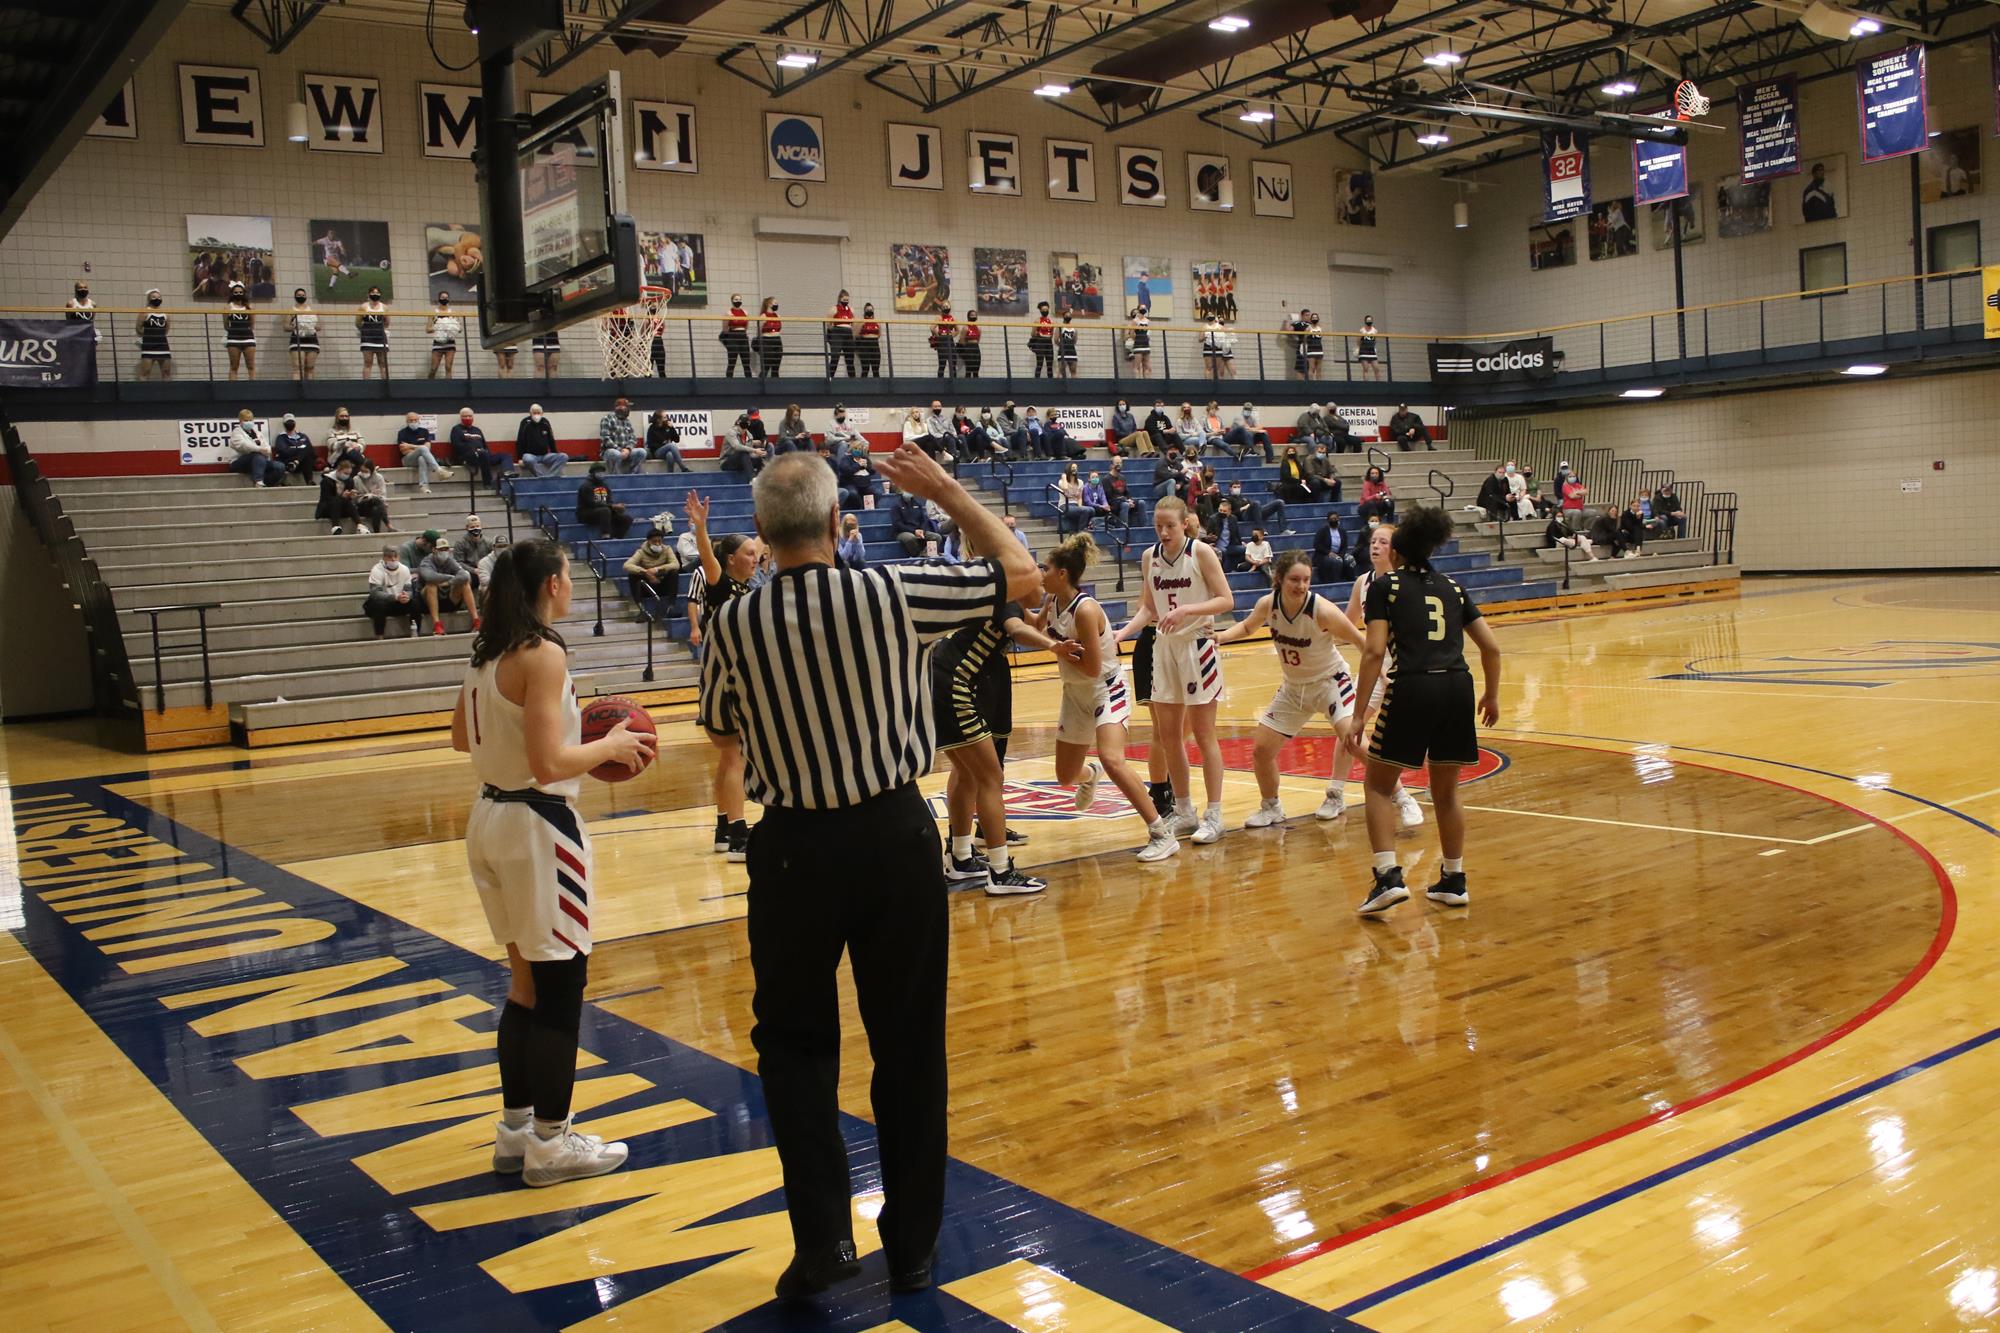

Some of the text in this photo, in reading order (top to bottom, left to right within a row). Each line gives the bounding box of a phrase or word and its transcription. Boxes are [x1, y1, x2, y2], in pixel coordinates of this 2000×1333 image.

[1872, 61, 1908, 76] SOFTBALL
[776, 144, 821, 161] NCAA
[1555, 157, 1577, 177] 32
[1475, 351, 1545, 372] adidas
[1056, 409, 1102, 418] GENERAL
[1339, 408, 1376, 416] GENERAL
[1059, 420, 1104, 429] DMISSION
[1424, 595, 1446, 641] 3
[1281, 648, 1301, 666] 13
